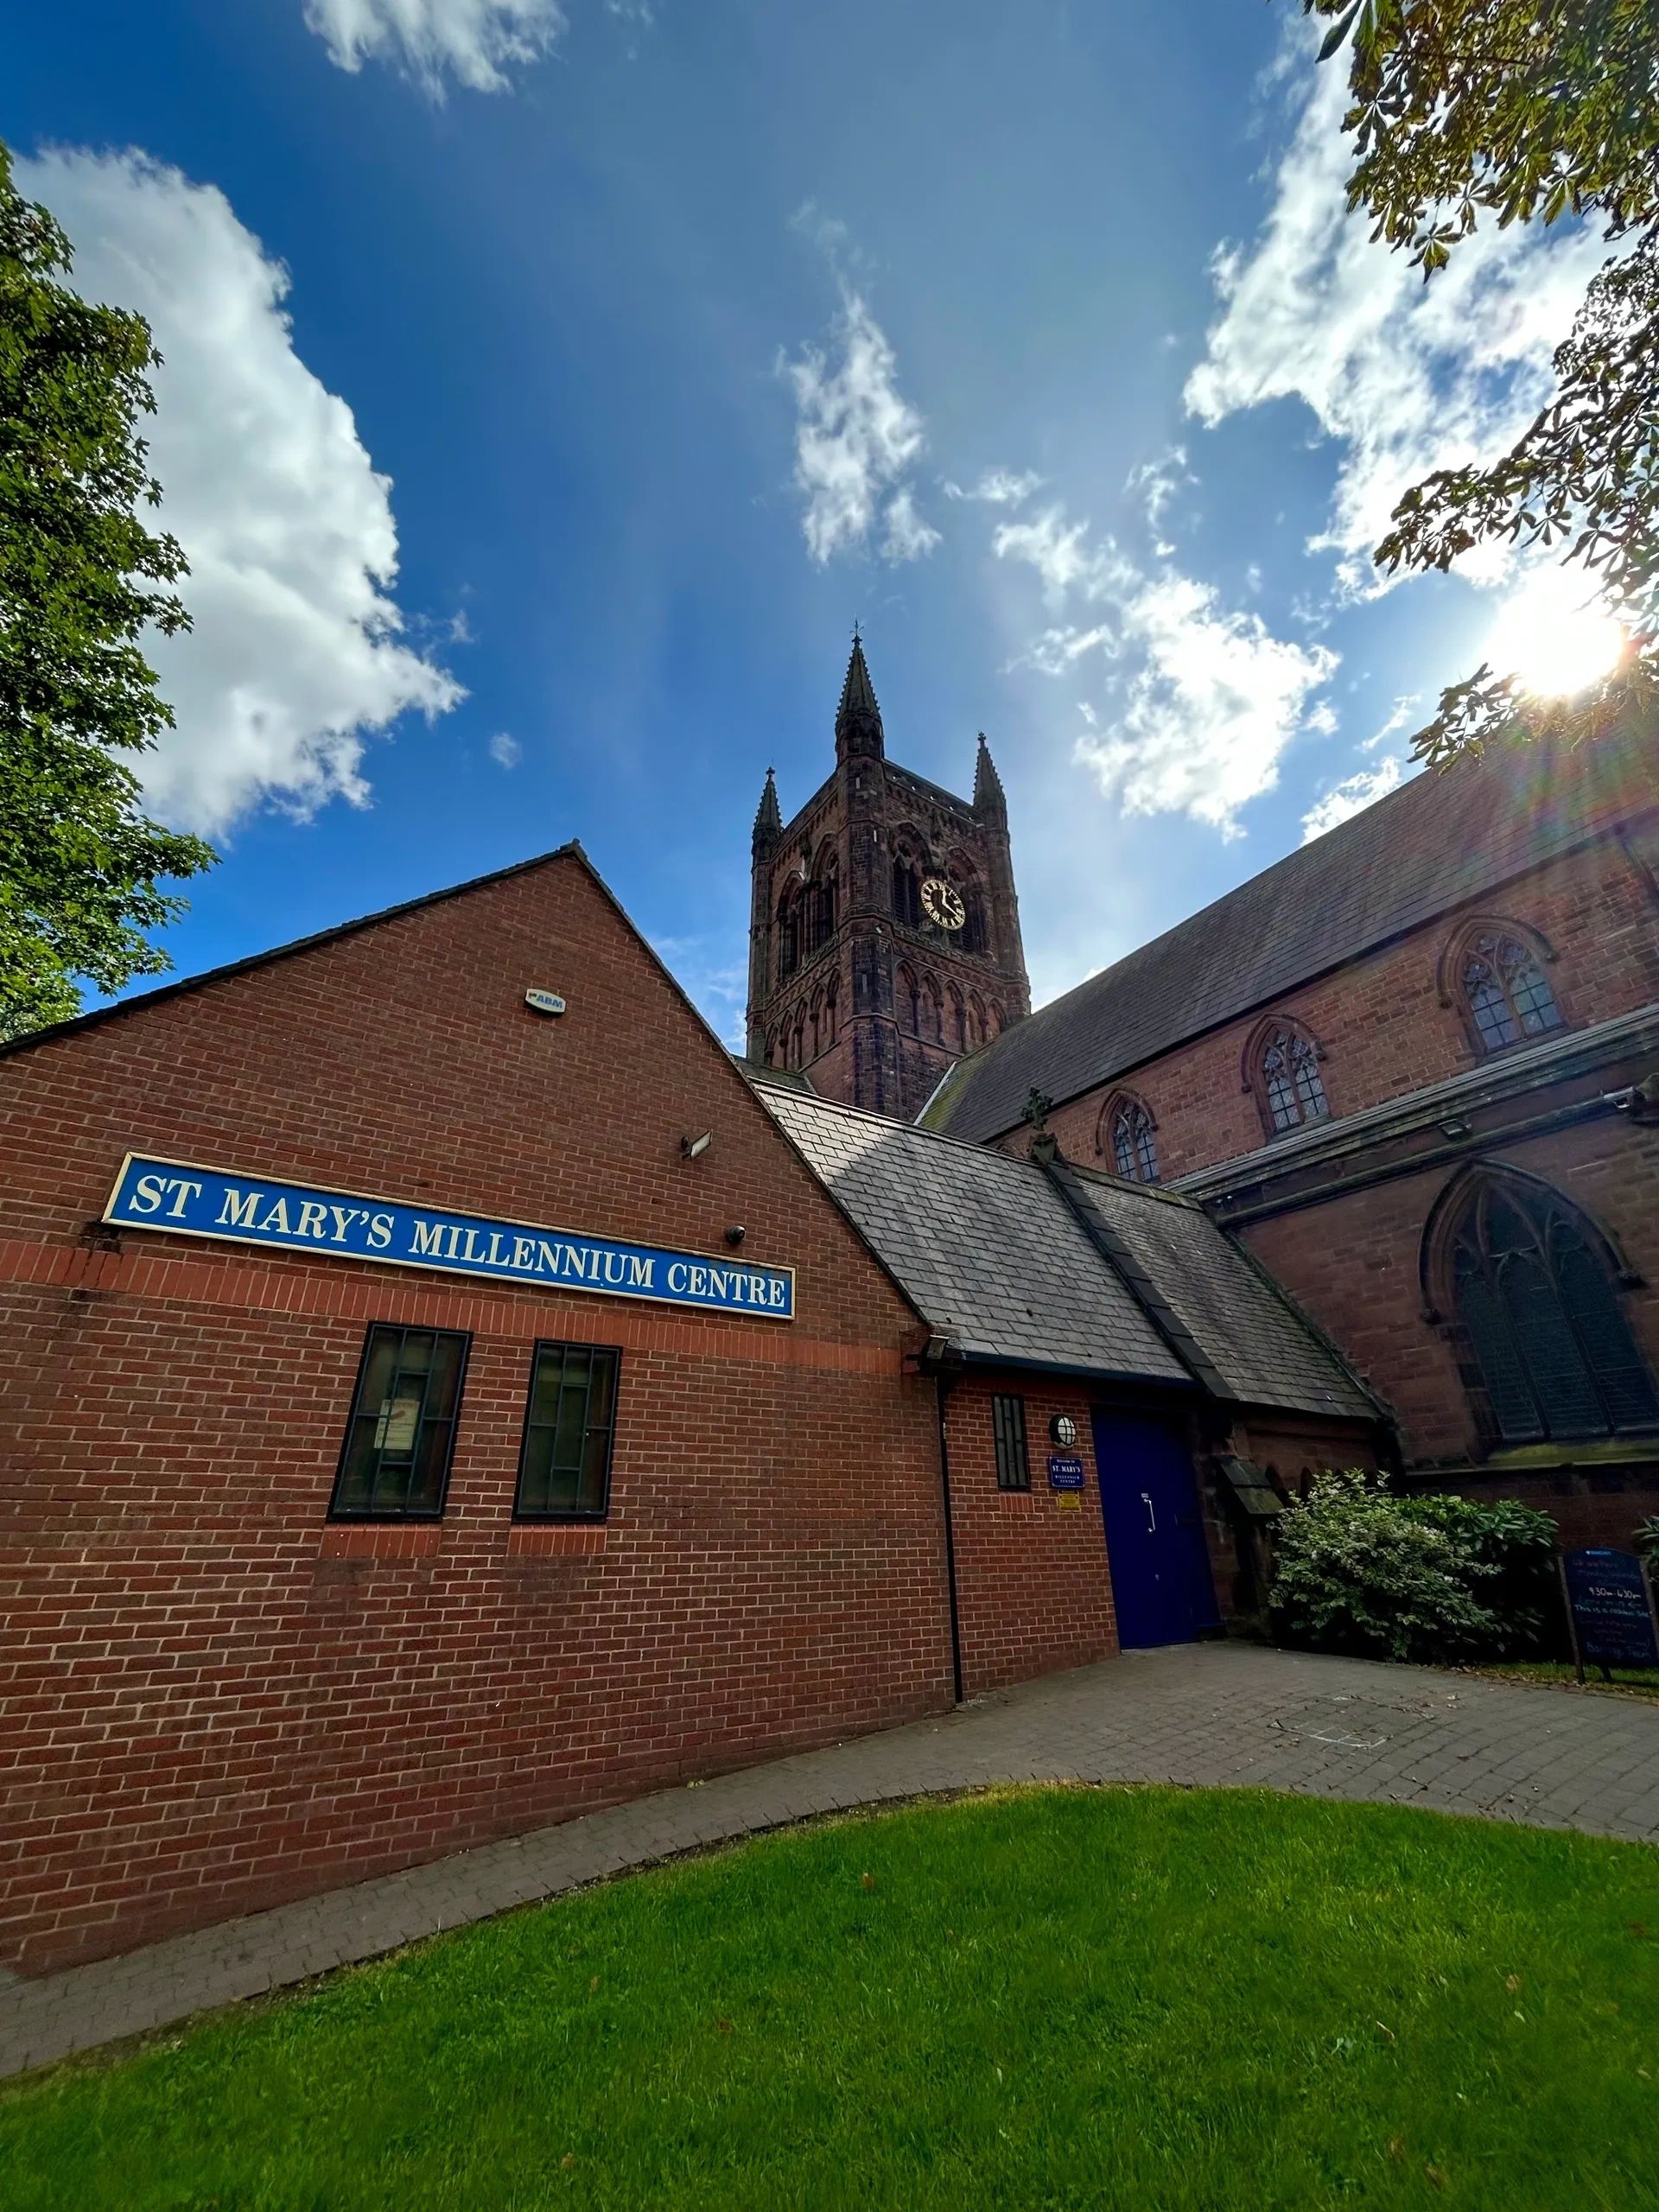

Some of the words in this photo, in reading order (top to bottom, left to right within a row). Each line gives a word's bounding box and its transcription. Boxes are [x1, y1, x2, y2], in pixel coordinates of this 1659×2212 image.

[129, 1174, 203, 1218] ST
[215, 1188, 395, 1249] MARY'S
[408, 1220, 655, 1288] MILLENNIUM
[667, 1262, 785, 1307] CENTRE
